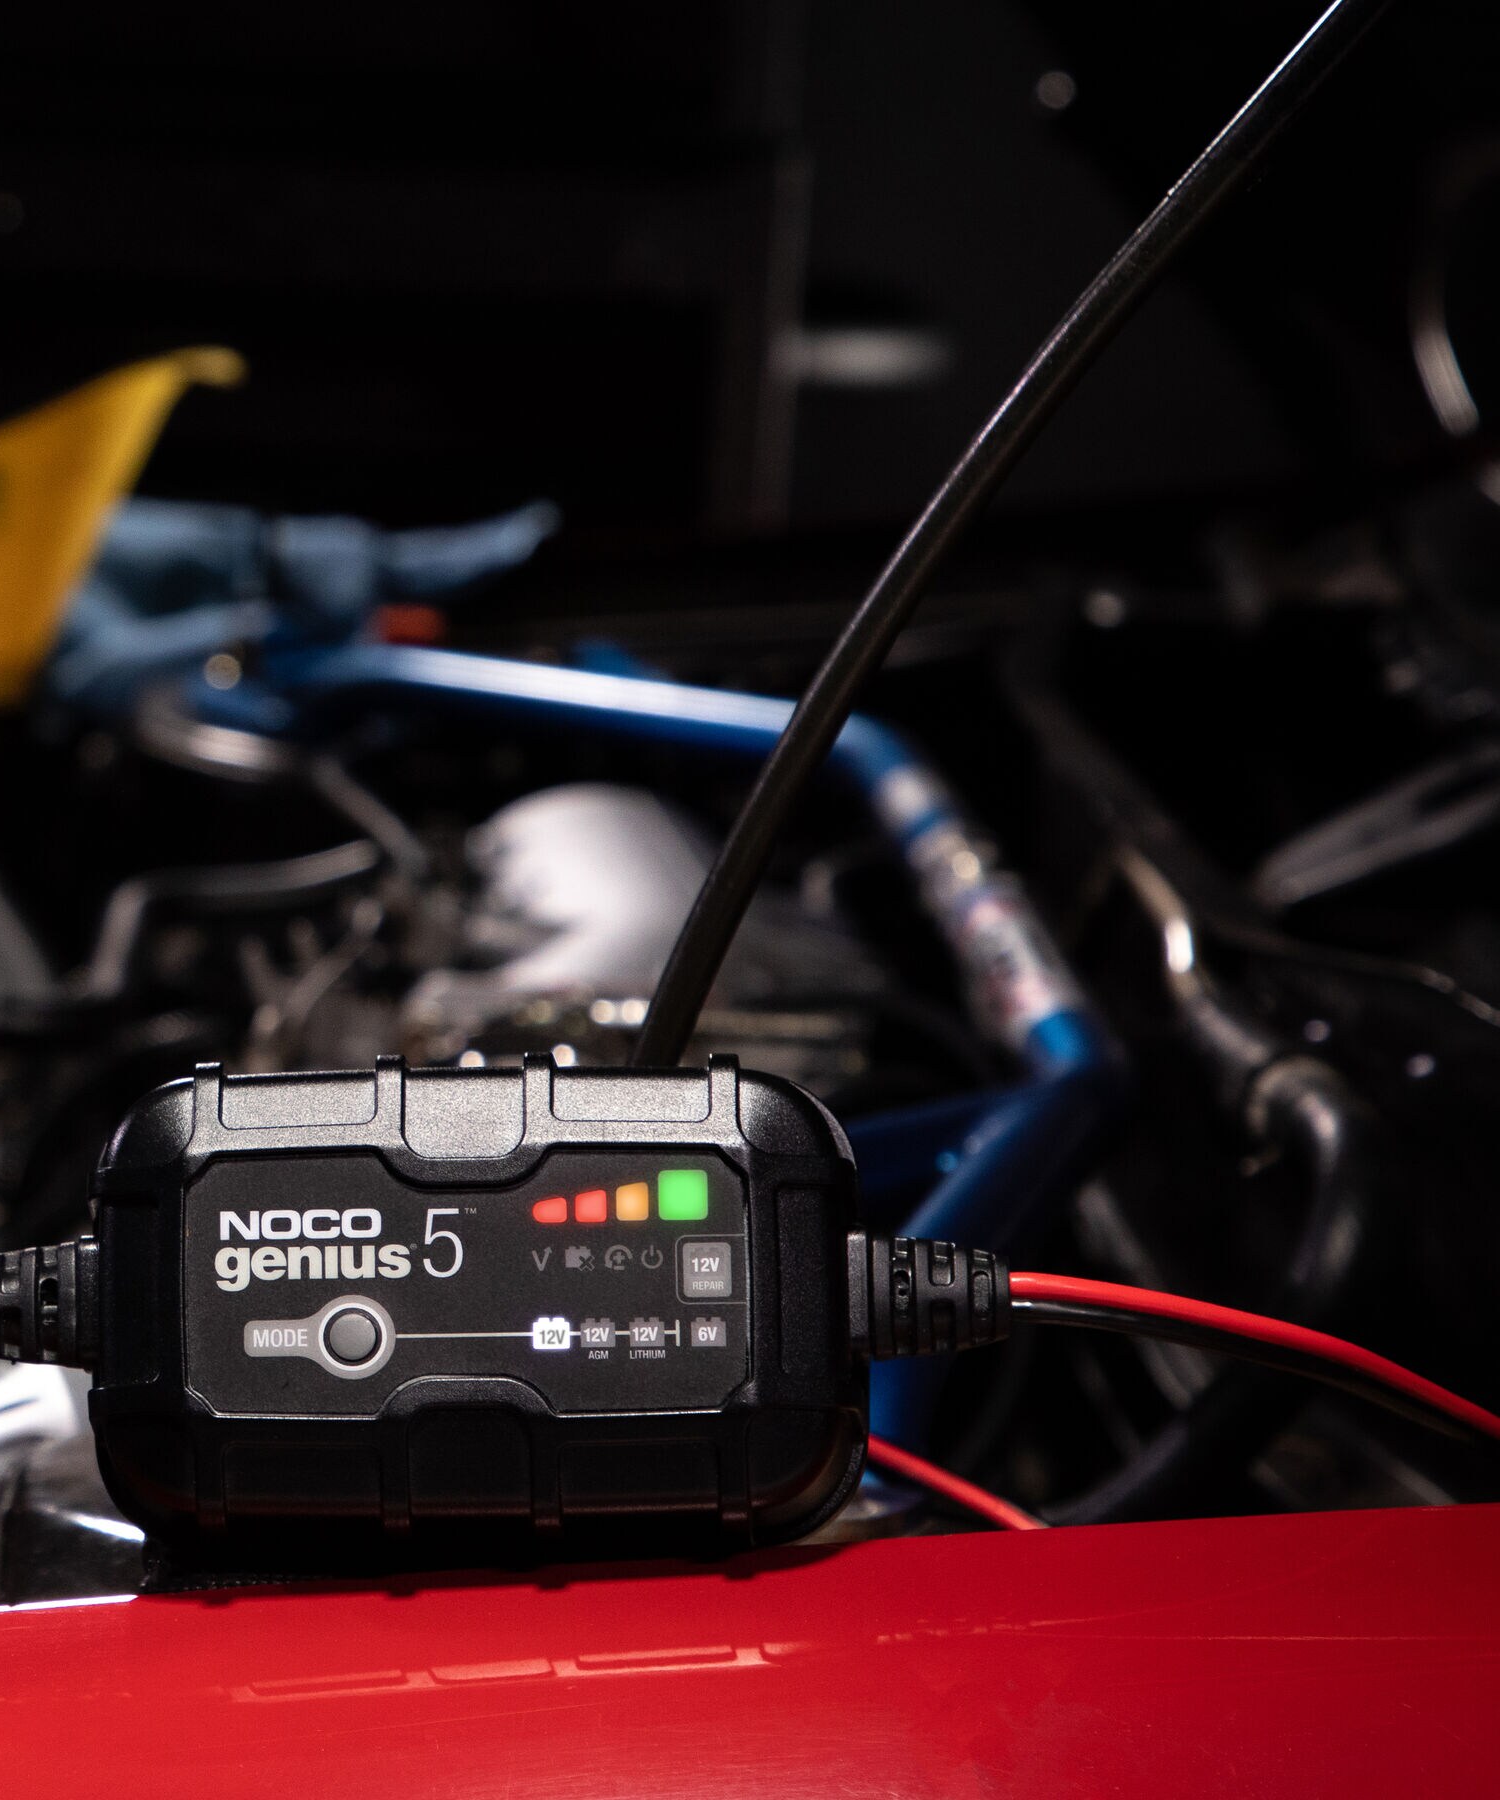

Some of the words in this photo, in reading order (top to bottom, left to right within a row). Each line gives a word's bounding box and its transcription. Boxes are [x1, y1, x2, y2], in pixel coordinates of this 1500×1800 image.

[219, 1207, 383, 1241] NOCO
[691, 1257, 720, 1273] 12V
[691, 1280, 725, 1291] REPAIR
[252, 1328, 309, 1348] MODE
[539, 1329, 566, 1346] 12V
[583, 1327, 610, 1343] 12V
[631, 1326, 659, 1342] 12V
[697, 1326, 718, 1342] 6V
[587, 1350, 609, 1360] AGM
[629, 1349, 667, 1360] LITHIUM
